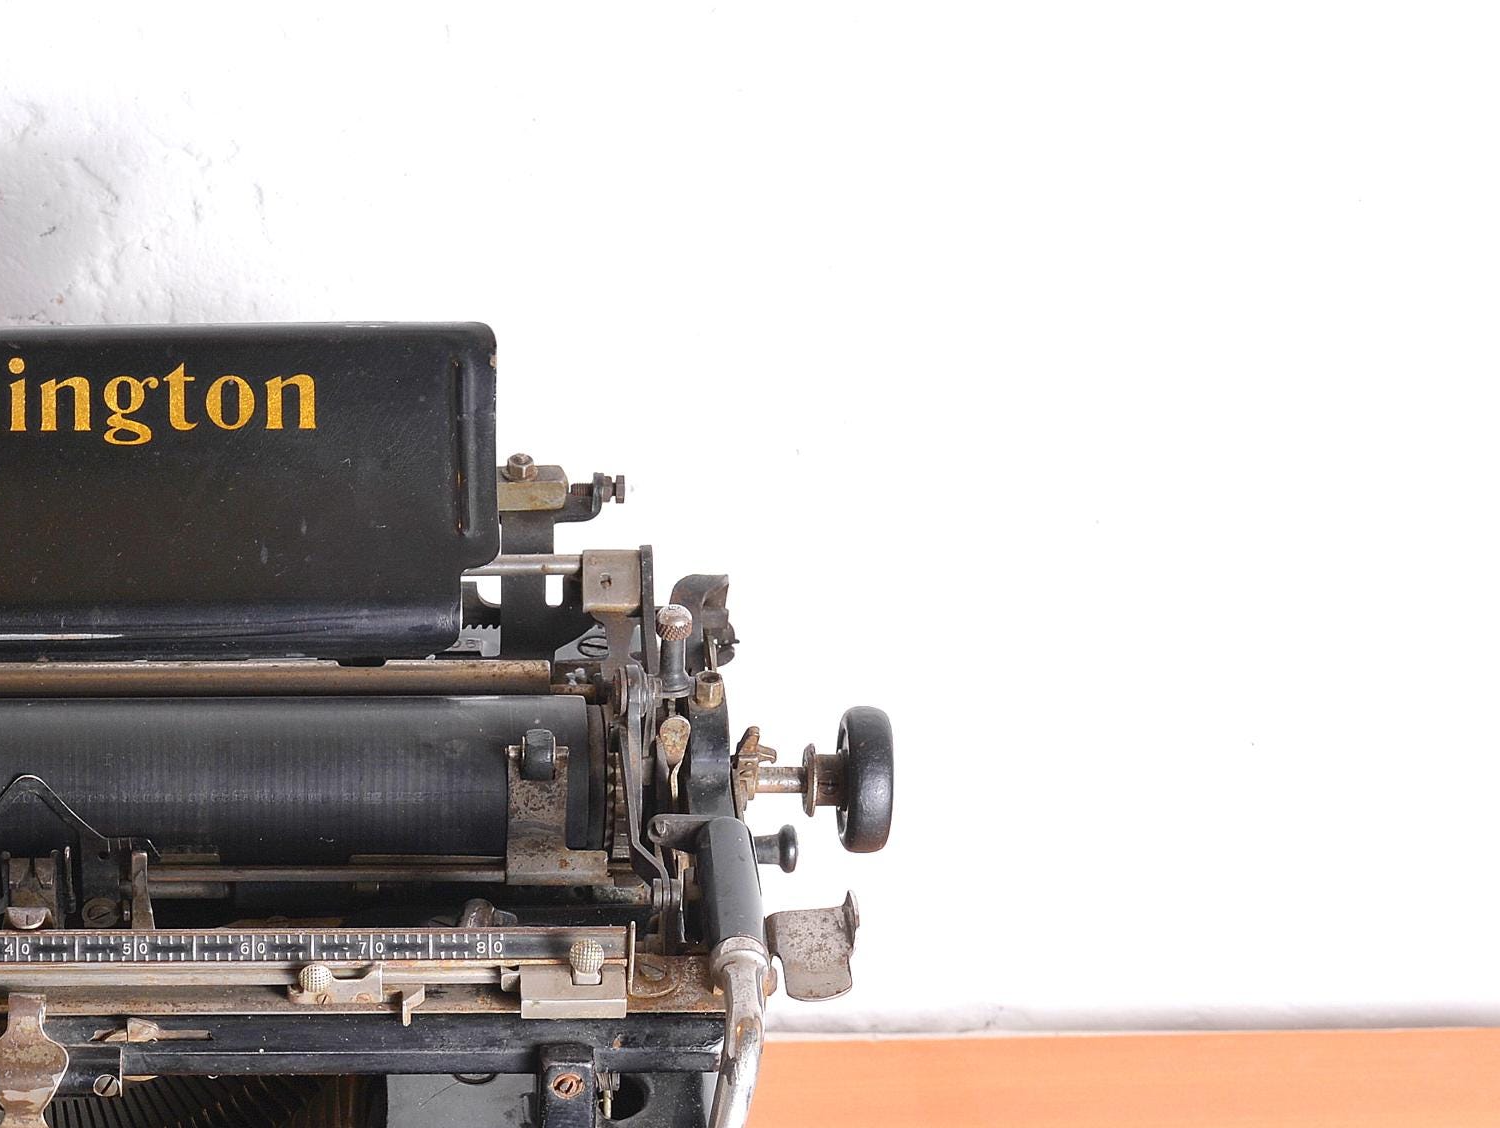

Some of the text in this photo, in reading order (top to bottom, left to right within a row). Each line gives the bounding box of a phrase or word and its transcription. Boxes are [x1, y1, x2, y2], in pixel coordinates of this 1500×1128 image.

[4, 943, 30, 956] 40
[122, 942, 148, 956] 50
[239, 942, 266, 955] 60
[358, 941, 384, 955] 70
[475, 941, 503, 955] 80
